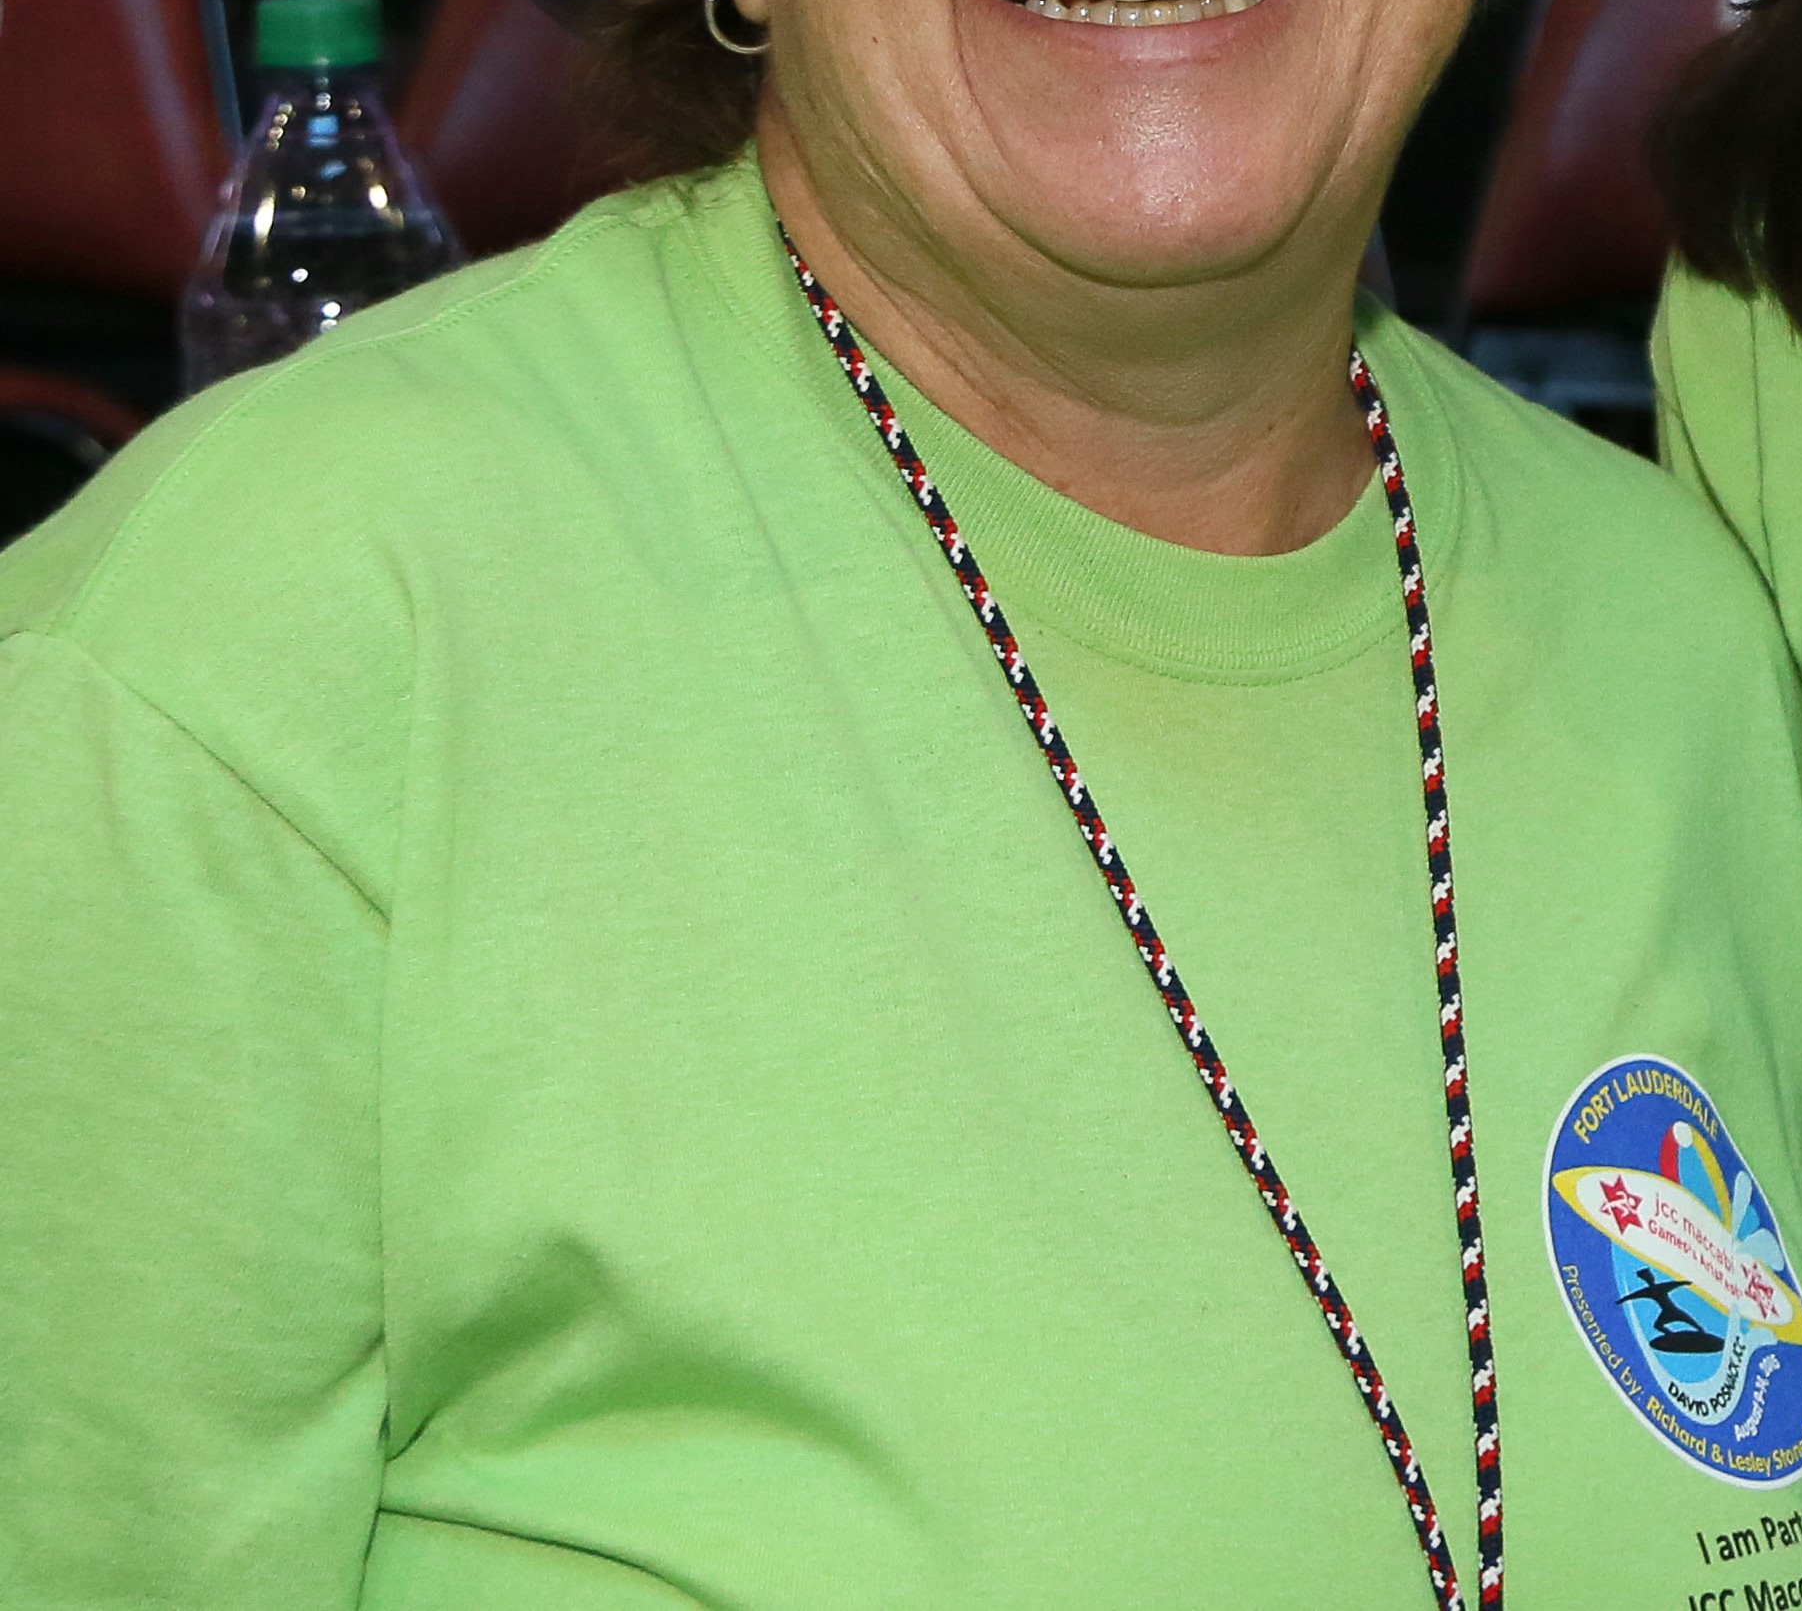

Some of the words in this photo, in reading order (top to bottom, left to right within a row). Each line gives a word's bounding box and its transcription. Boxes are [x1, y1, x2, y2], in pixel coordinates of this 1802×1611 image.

[1572, 1084, 1615, 1145] FORT
[1612, 1068, 1719, 1142] LAUDERDALE
[1654, 1191, 1679, 1225] jcc
[1682, 1216, 1736, 1276] maccabi
[1561, 1264, 1624, 1370] Presented
[1644, 1395, 1708, 1456] Richard
[1710, 1442, 1725, 1466] &
[1727, 1447, 1773, 1477] Lesley
[1667, 1380, 1710, 1417] DAVID
[1709, 1360, 1740, 1414] POSNACK
[1733, 1335, 1747, 1363] JCC
[1733, 1399, 1765, 1442] August
[1695, 1531, 1711, 1566] I
[1716, 1527, 1761, 1562] am
